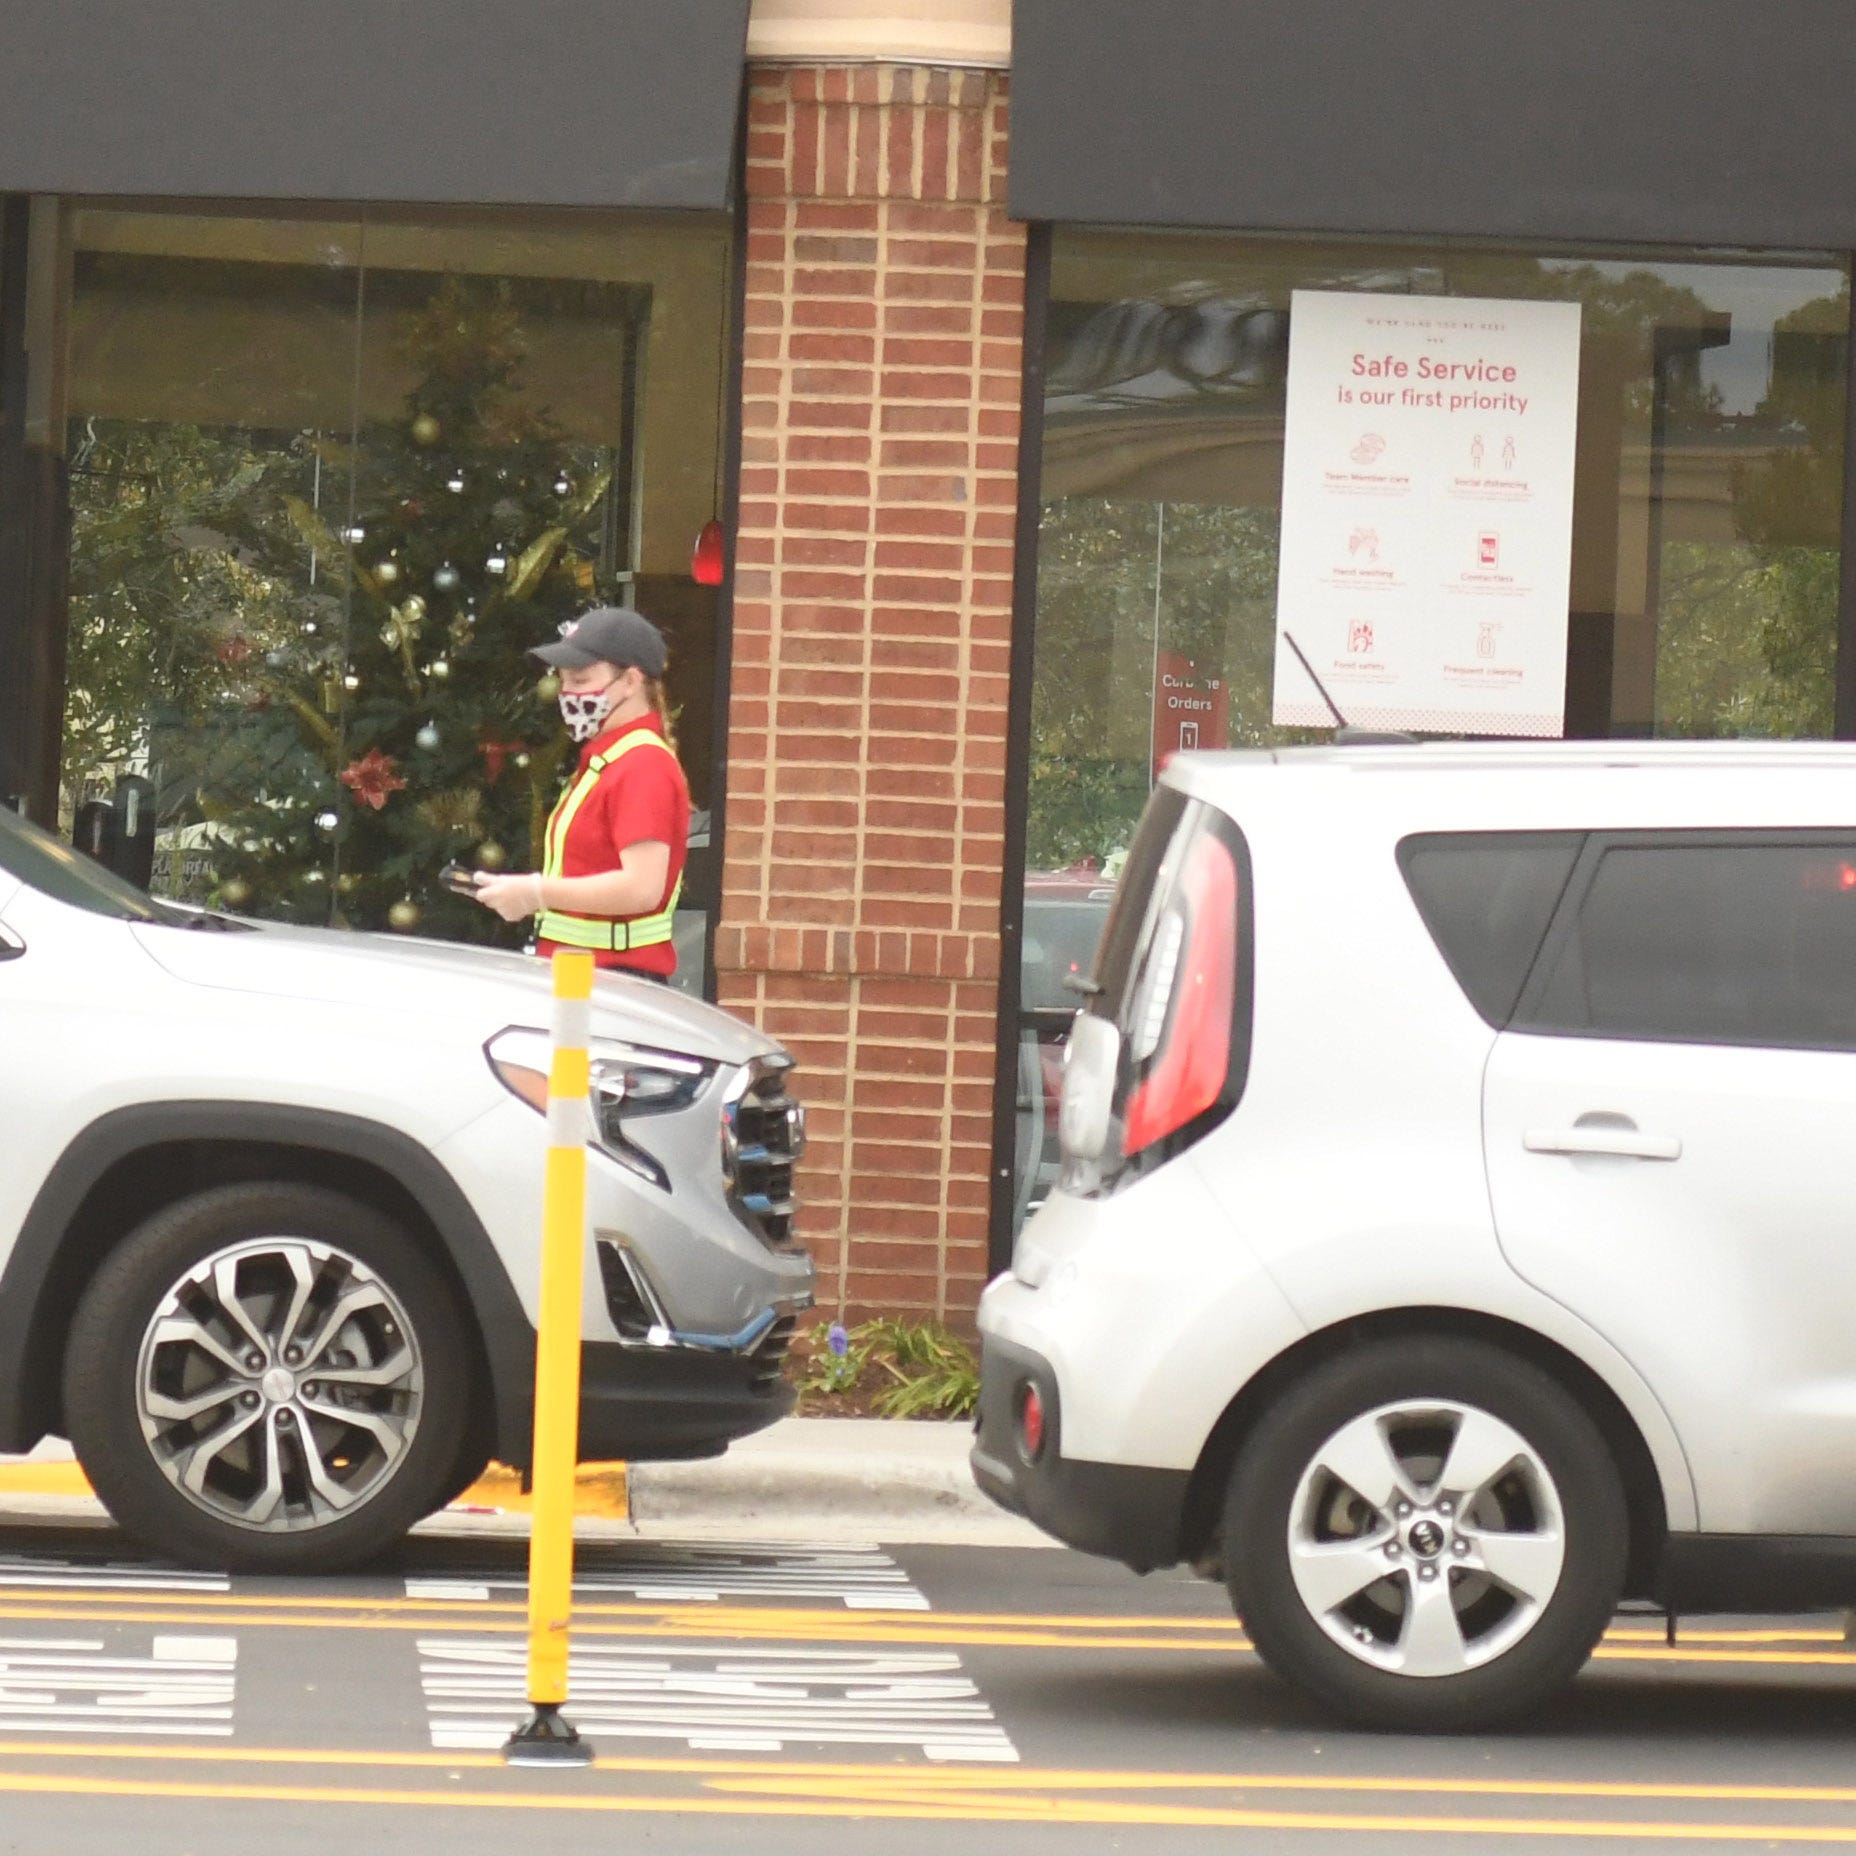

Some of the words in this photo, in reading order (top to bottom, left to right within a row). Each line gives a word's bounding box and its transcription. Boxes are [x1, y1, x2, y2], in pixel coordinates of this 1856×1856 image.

[1351, 354, 1408, 378] Safe
[1417, 357, 1517, 383] Service
[1337, 385, 1353, 404] is
[1359, 390, 1396, 405] our
[1402, 388, 1443, 408] first
[1449, 390, 1529, 416] priority
[1167, 696, 1213, 711] Orders
